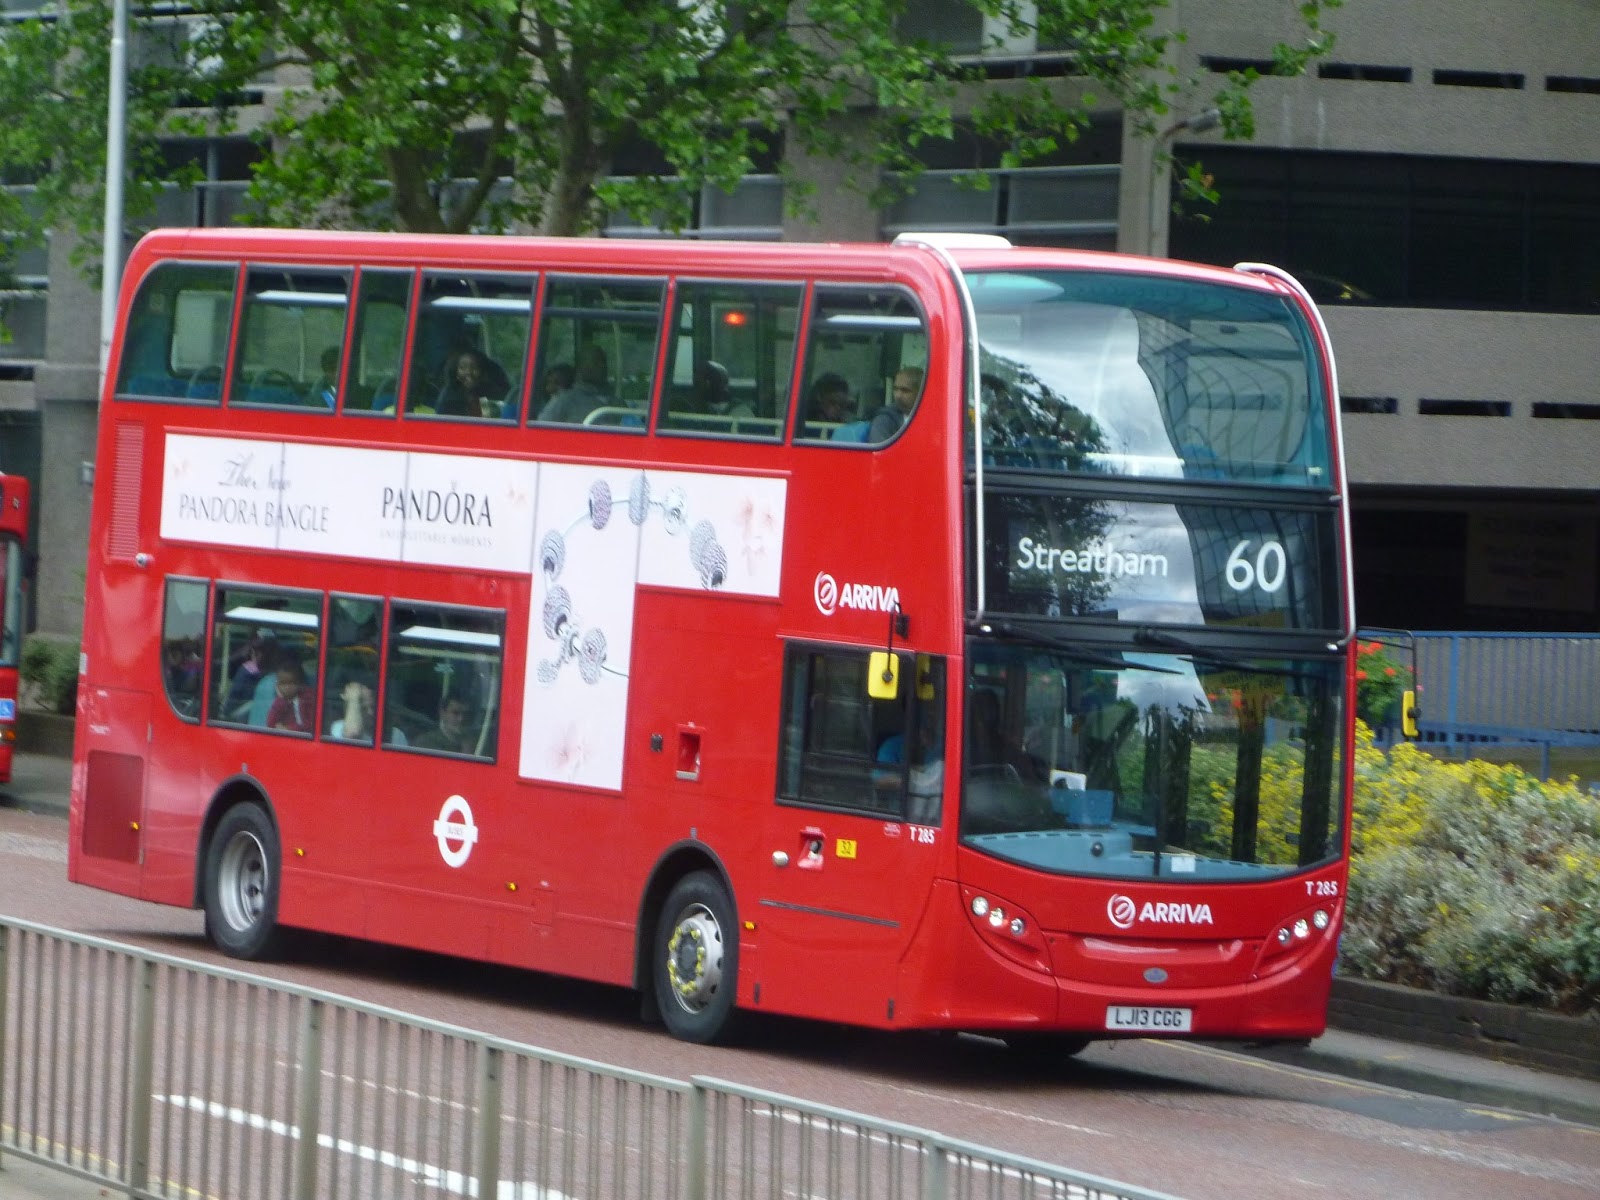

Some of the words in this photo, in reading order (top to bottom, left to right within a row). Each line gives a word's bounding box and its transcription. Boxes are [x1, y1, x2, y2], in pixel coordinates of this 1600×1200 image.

[178, 493, 259, 527] PANDORA
[264, 501, 330, 533] BANGLE
[382, 485, 492, 528] PANDORA
[1017, 537, 1168, 577] Streatham
[1226, 540, 1286, 593] 60
[839, 583, 900, 613] ARRIVA
[1305, 881, 1314, 896] T
[1316, 881, 1338, 896] 285
[1139, 901, 1213, 924] ARRIVA
[1115, 1008, 1148, 1026] LJ13
[1152, 1010, 1182, 1027] CGG
